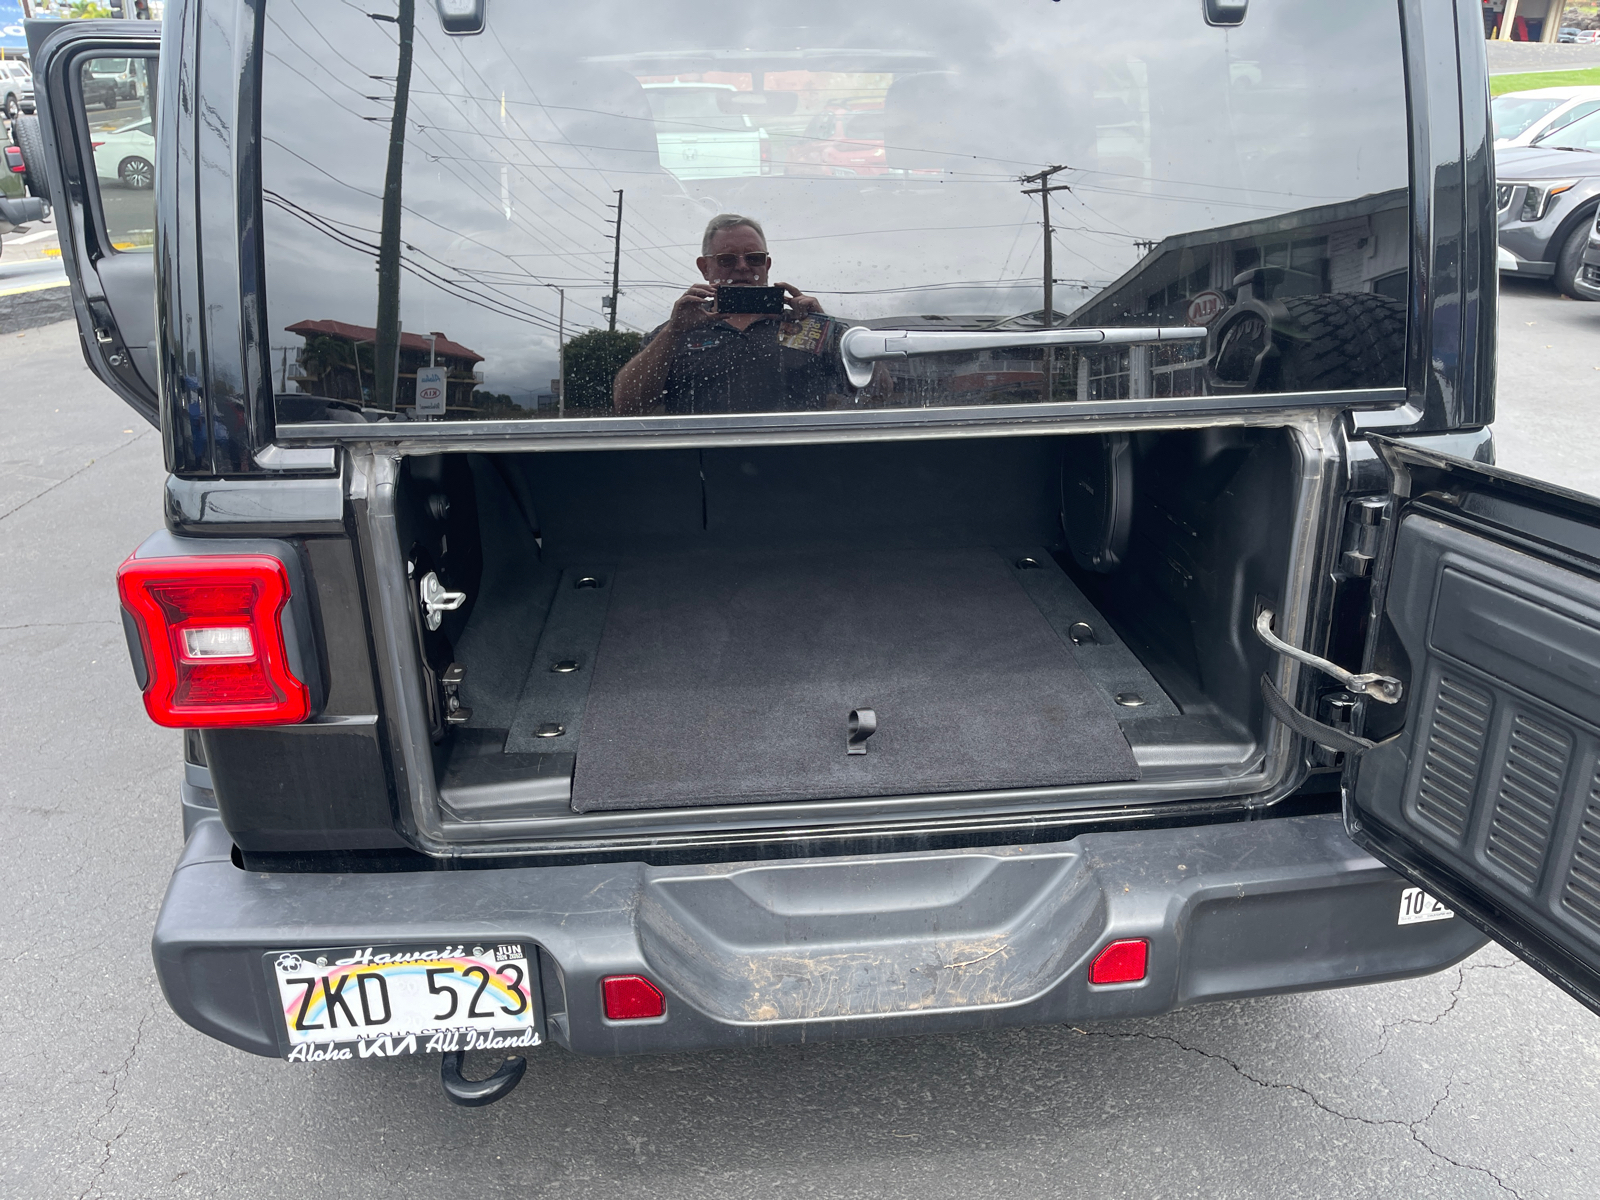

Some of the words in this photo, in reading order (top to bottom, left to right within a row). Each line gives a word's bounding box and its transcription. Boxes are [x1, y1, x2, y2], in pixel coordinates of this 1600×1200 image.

[1404, 891, 1425, 915] 10
[335, 945, 465, 966] Hawaii
[496, 944, 521, 956] JUN
[286, 972, 391, 1031] ZKD
[426, 963, 528, 1020] 523
[288, 1040, 353, 1062] Aloha
[425, 1030, 459, 1053] All
[464, 1026, 541, 1051] Islands
